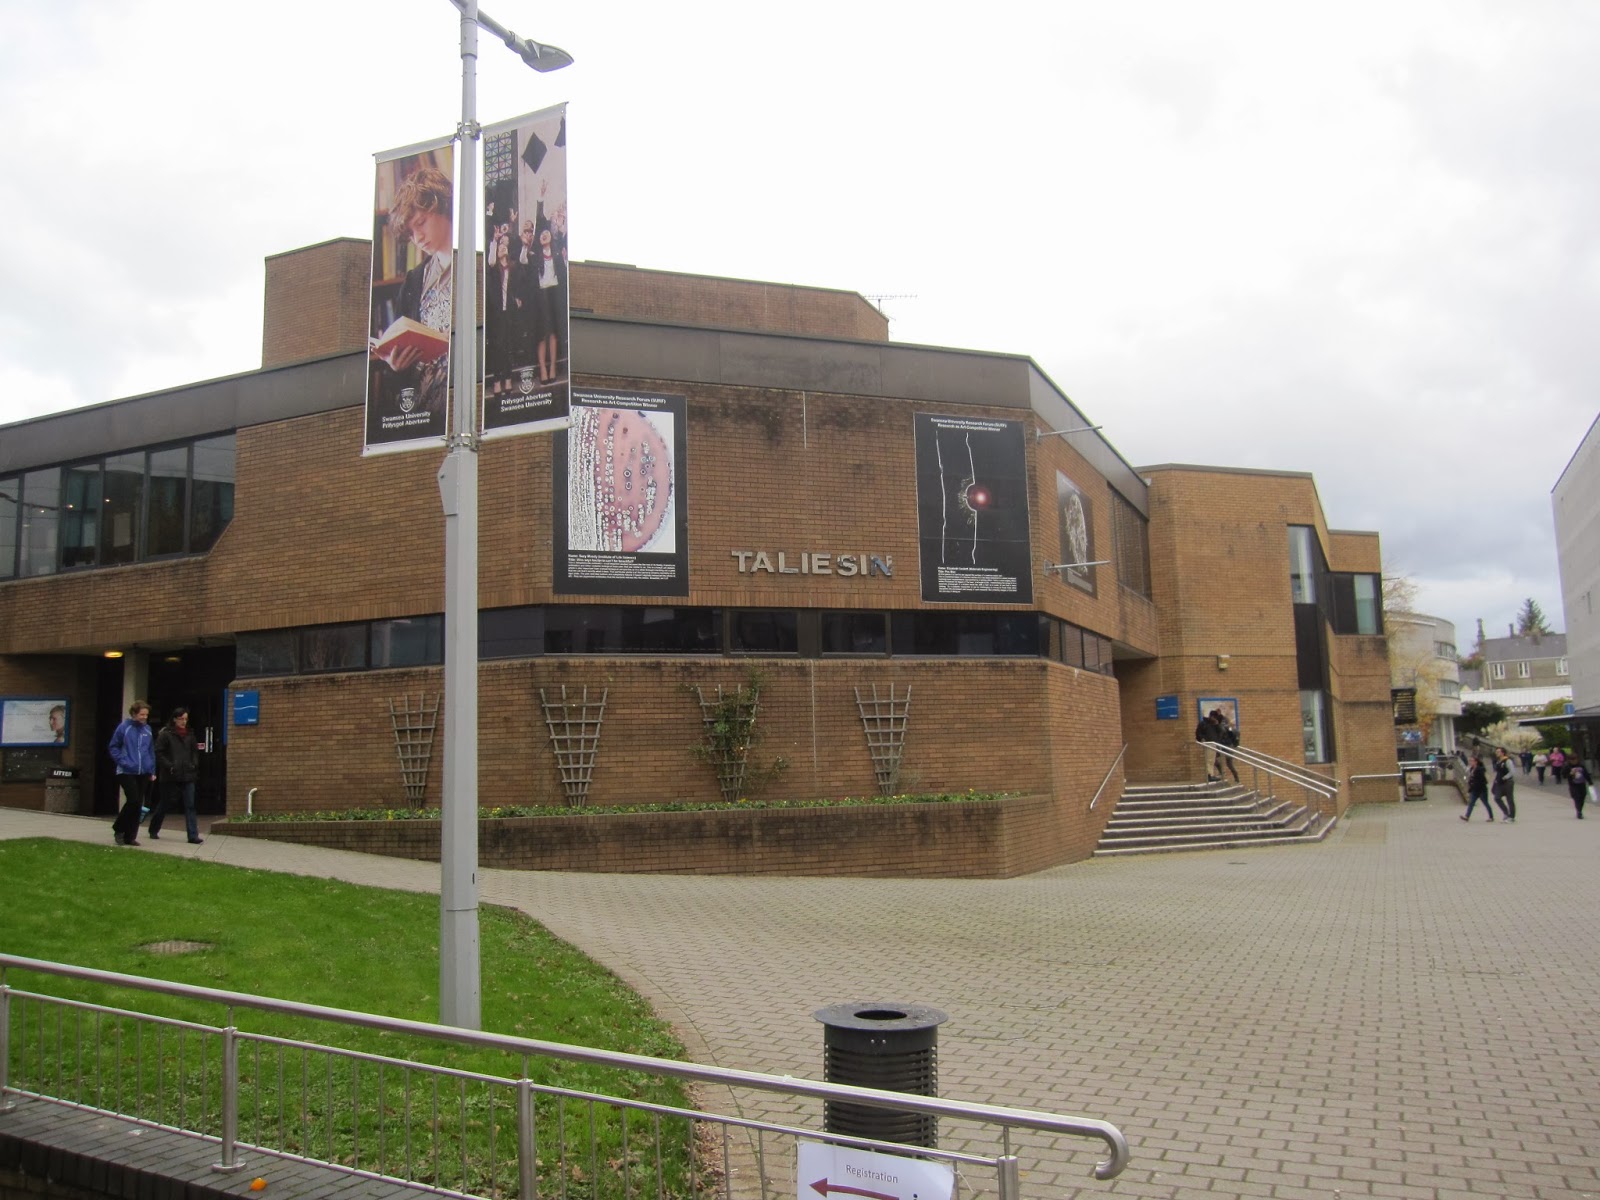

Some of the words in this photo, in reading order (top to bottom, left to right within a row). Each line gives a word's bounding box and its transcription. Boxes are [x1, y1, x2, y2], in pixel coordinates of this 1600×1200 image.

[525, 392, 552, 401] Abertawe
[500, 403, 525, 412] Swansea
[525, 399, 553, 408] University
[382, 414, 405, 422] Swansea
[405, 411, 431, 420] University
[405, 417, 431, 426] Abertawe
[731, 550, 893, 577] TALIESIN
[845, 1164, 899, 1184] Registration
